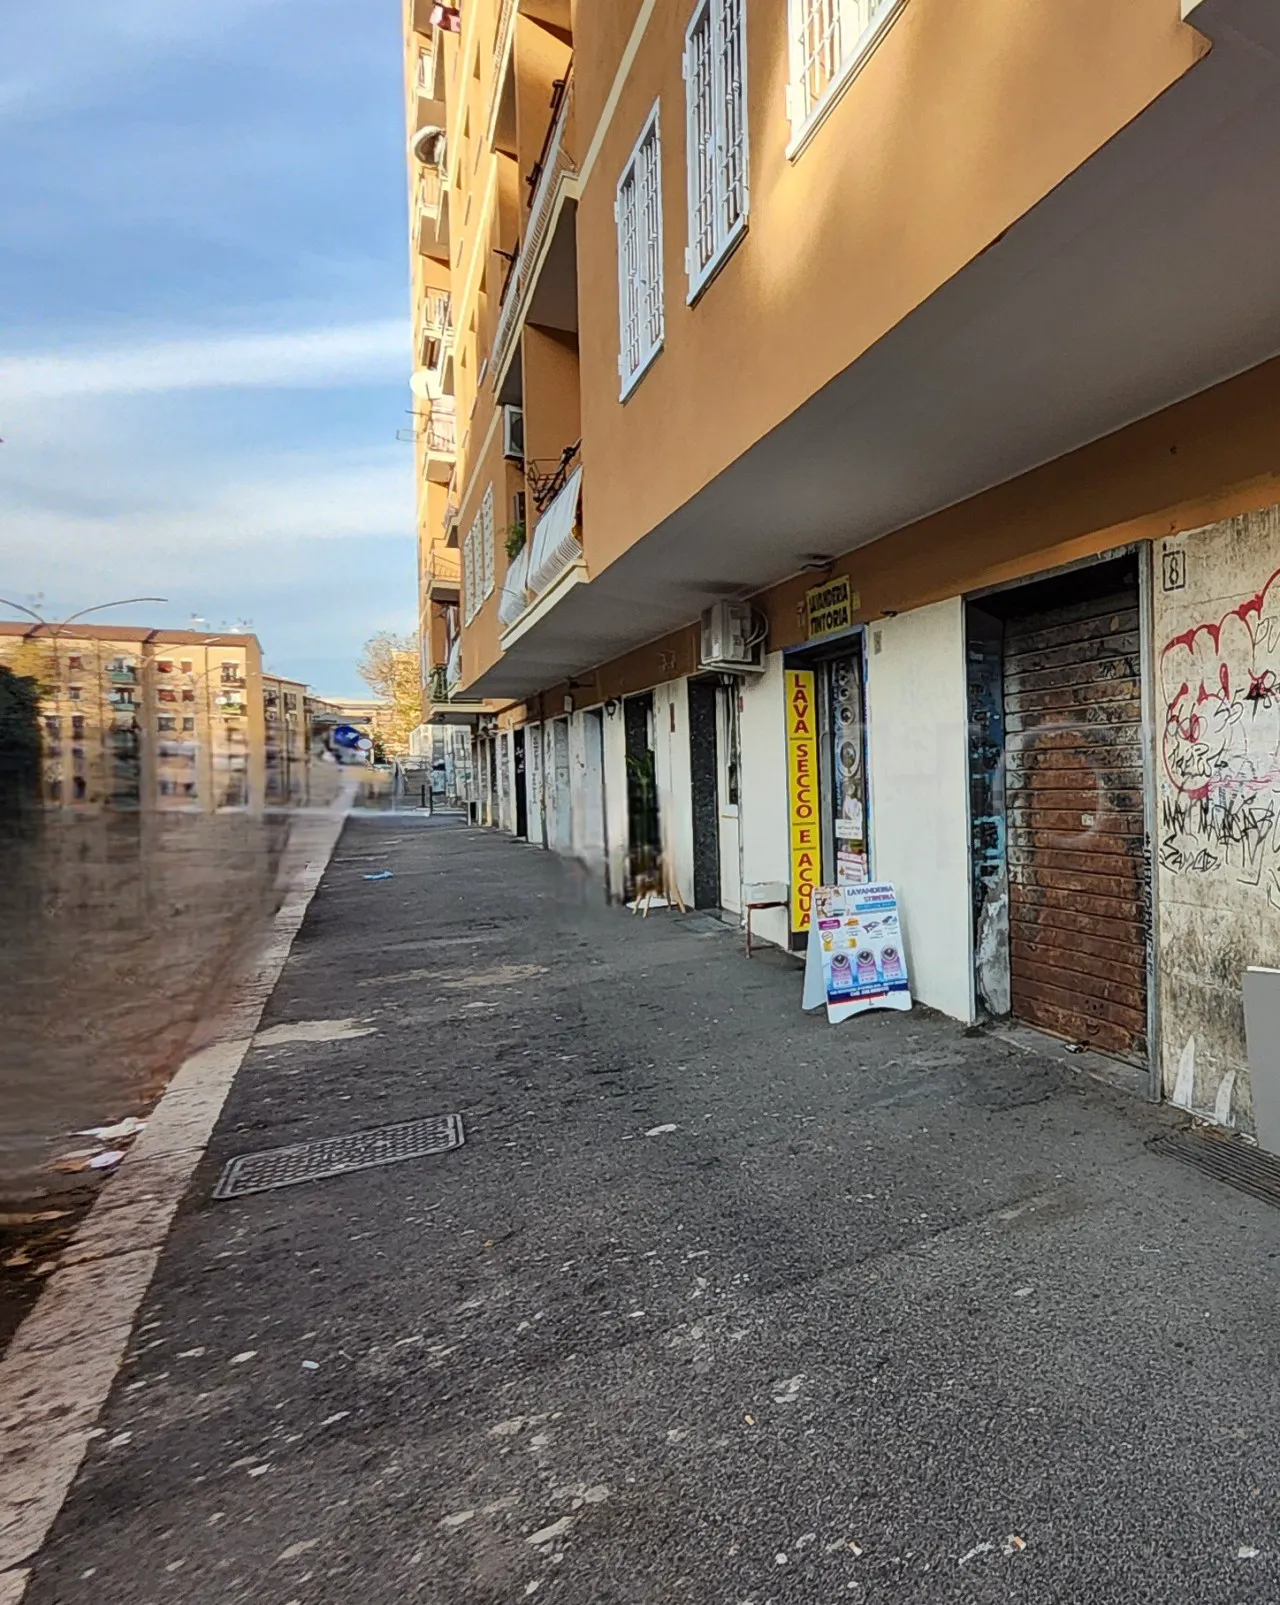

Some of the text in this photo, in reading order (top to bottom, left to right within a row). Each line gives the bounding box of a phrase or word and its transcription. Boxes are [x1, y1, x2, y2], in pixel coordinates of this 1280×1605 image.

[1168, 556, 1179, 586] 8
[809, 582, 848, 614] LAVANDERIA
[810, 606, 848, 635] TINTORIA
[792, 673, 814, 928] LAVA SECCO E ACQUA
